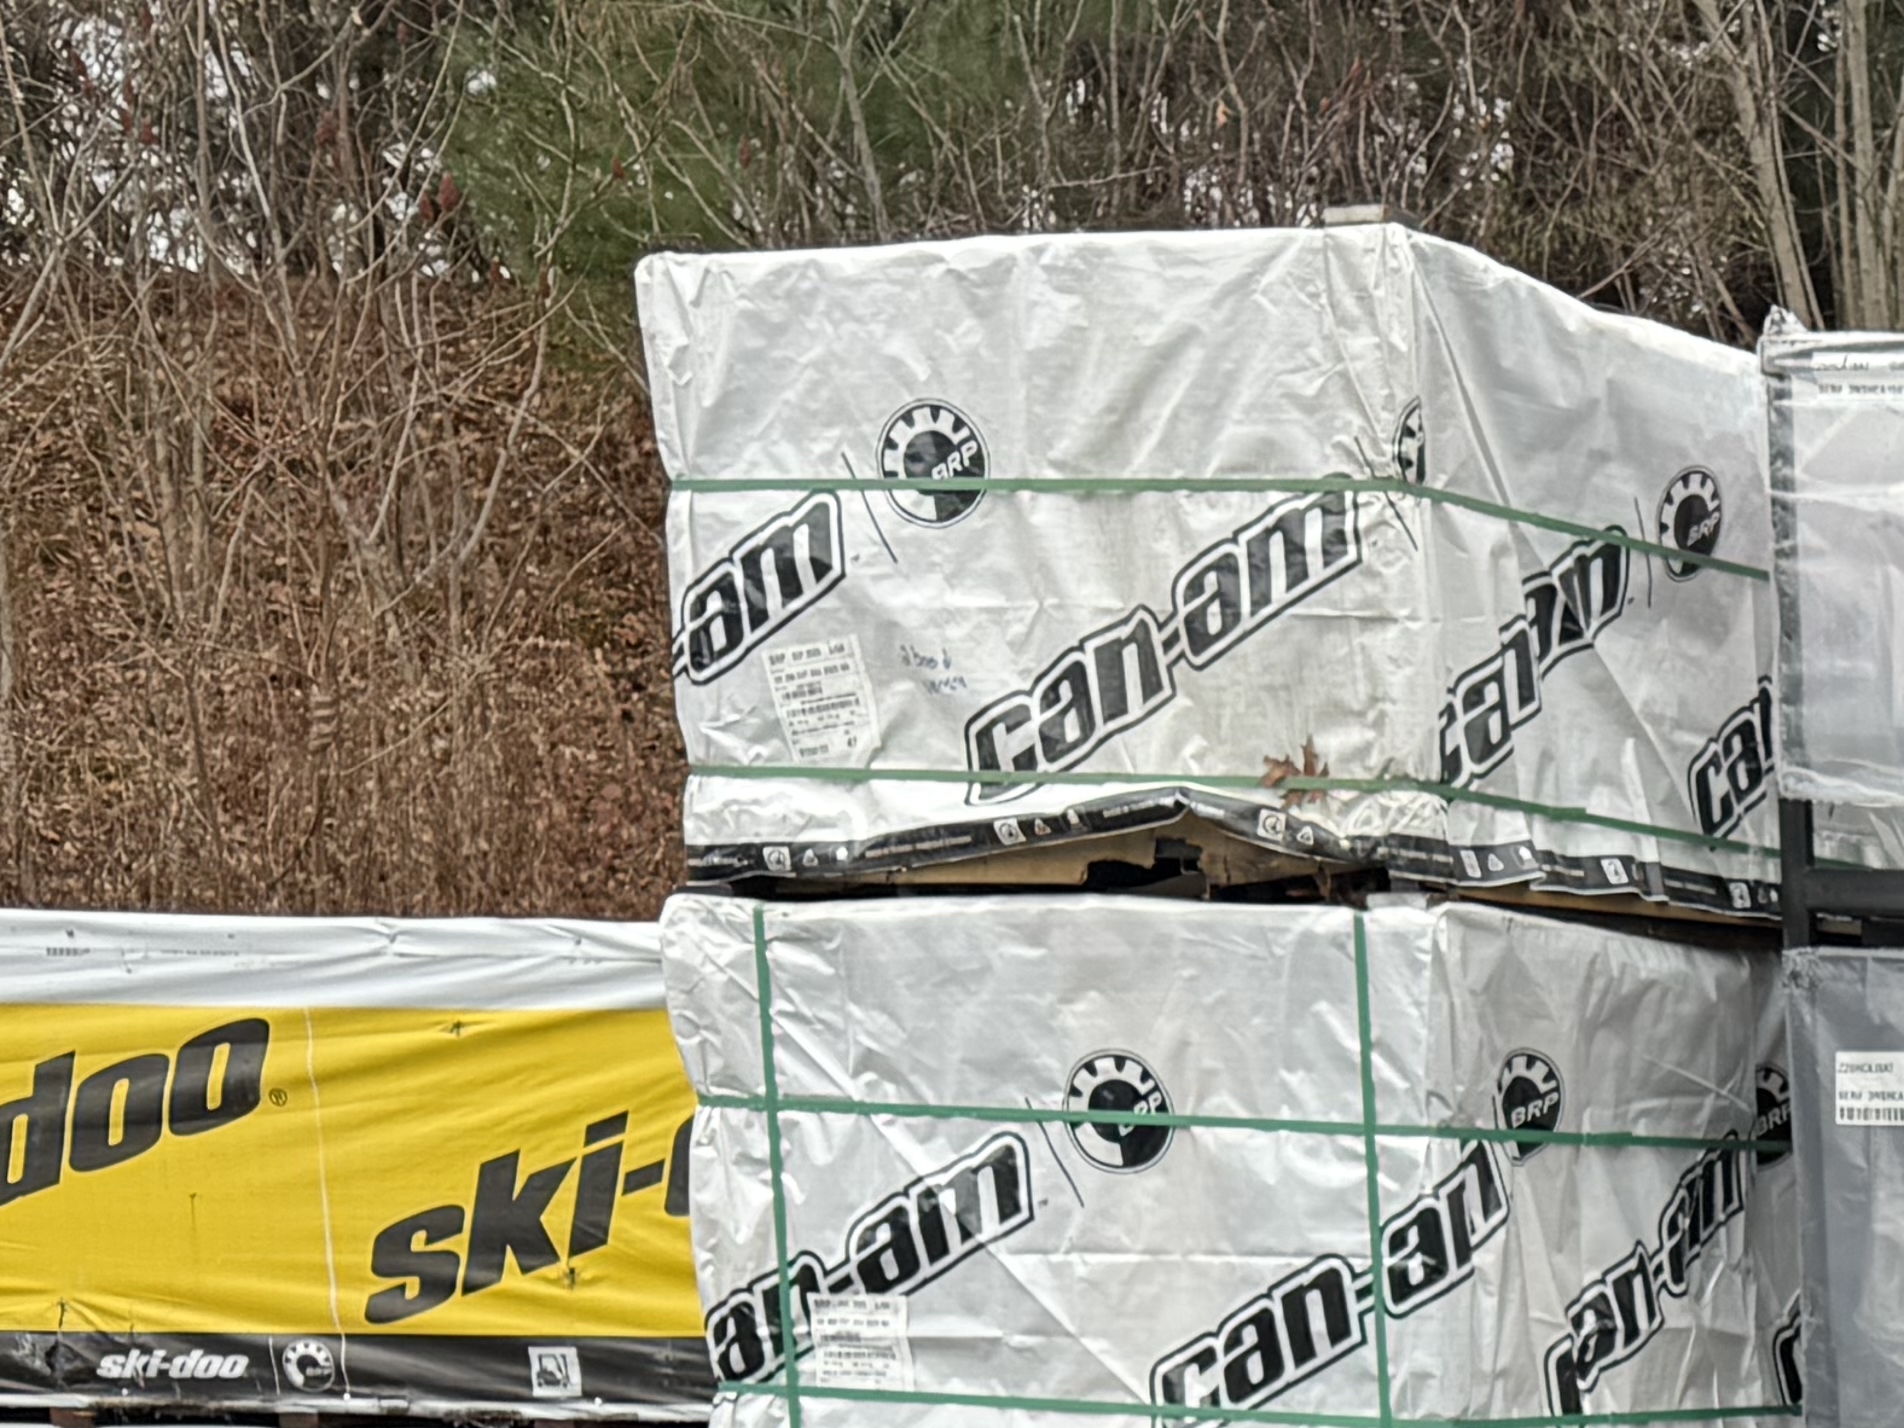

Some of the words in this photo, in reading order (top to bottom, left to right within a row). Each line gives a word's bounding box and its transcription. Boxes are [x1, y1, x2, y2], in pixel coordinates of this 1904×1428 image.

[964, 472, 1361, 804] can-am
[1510, 1092, 1560, 1127] BRP
[96, 1349, 250, 1379] ski-doo
